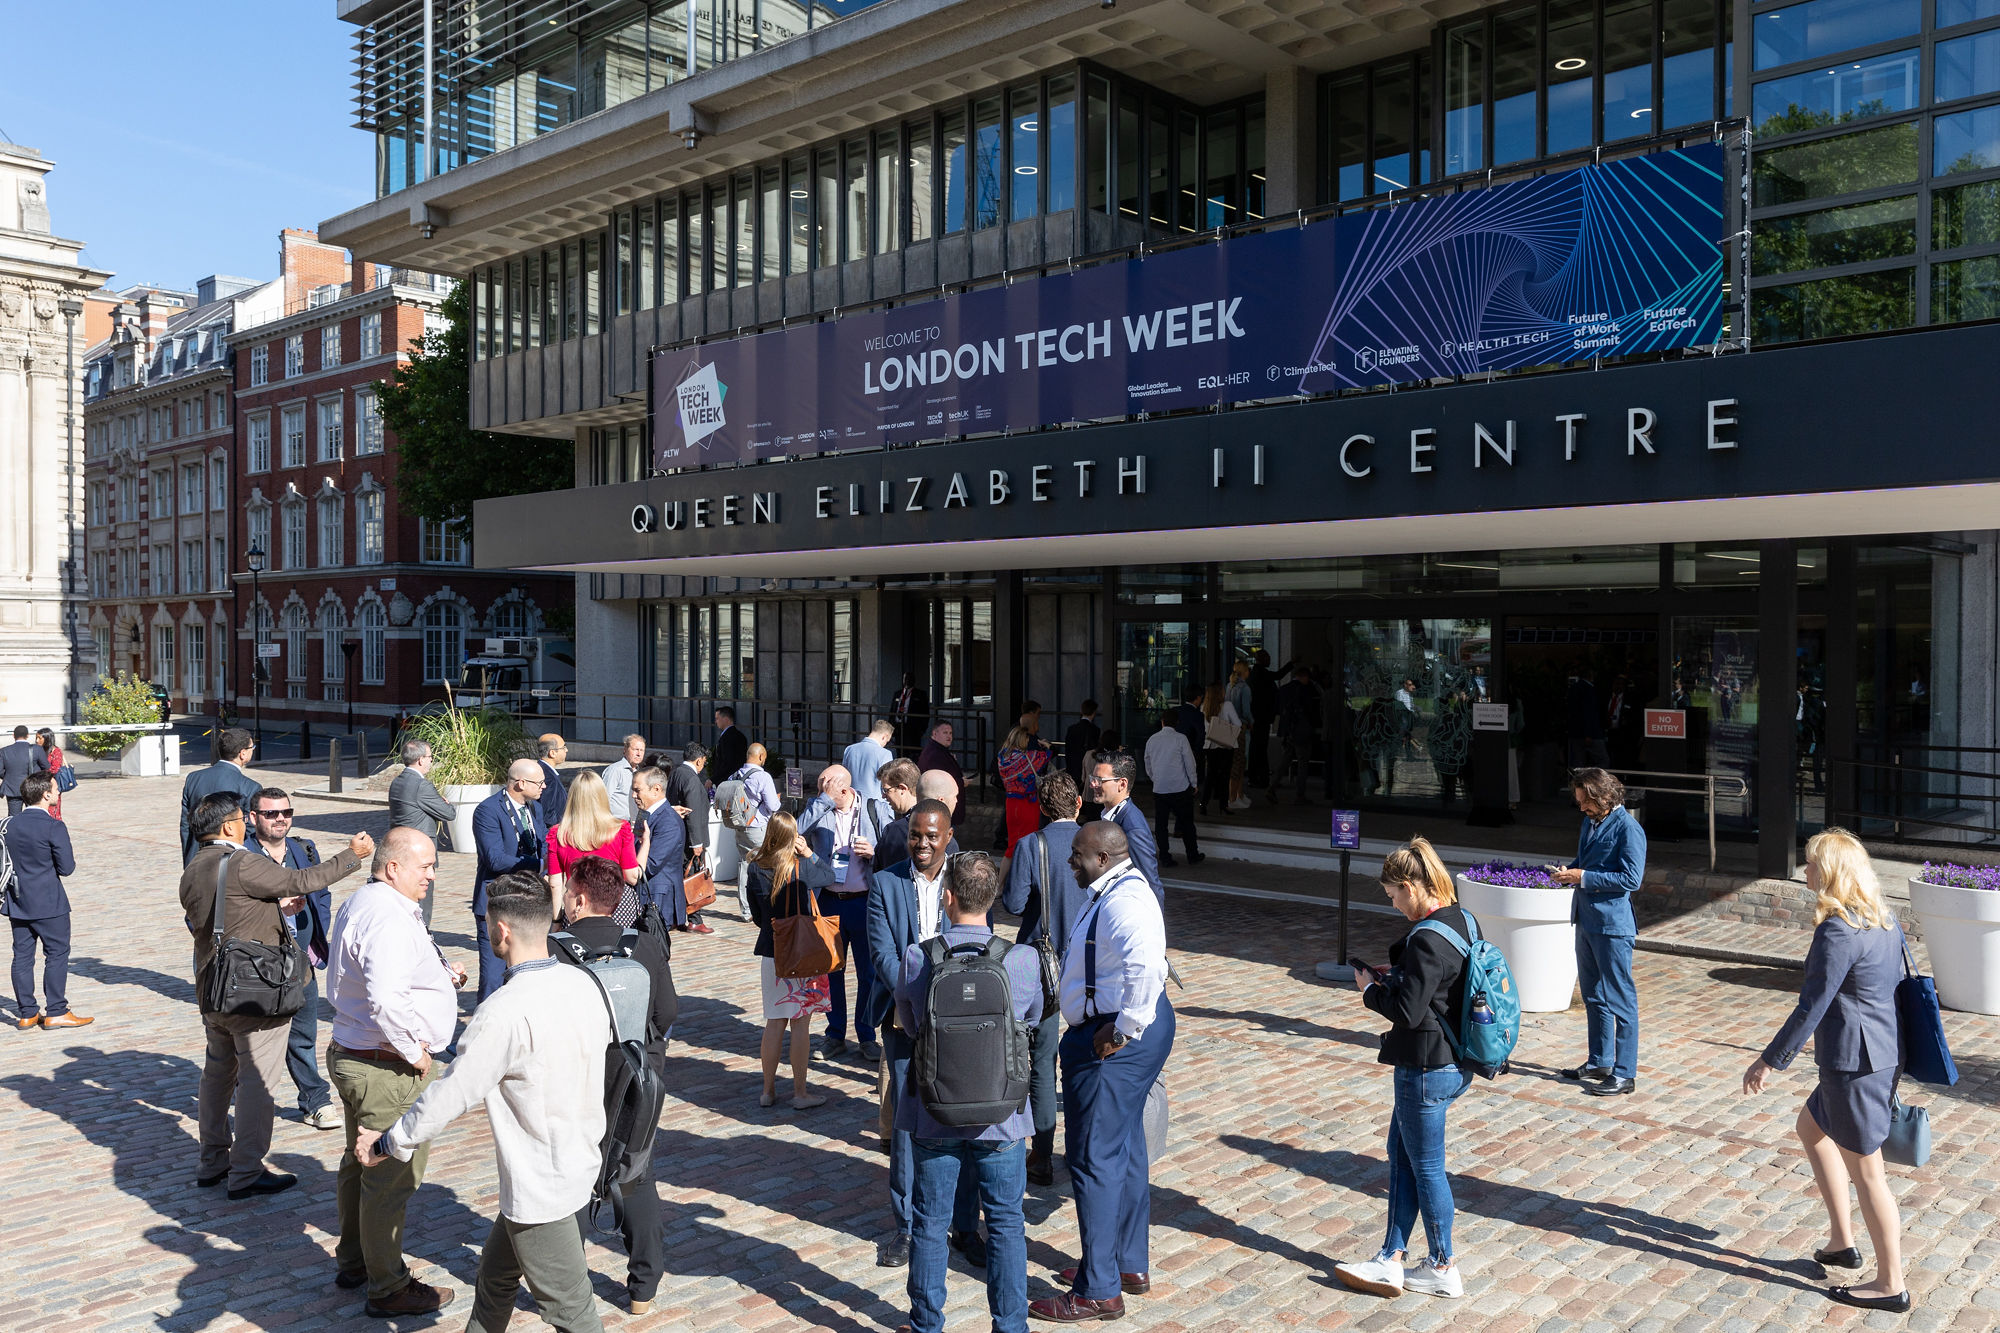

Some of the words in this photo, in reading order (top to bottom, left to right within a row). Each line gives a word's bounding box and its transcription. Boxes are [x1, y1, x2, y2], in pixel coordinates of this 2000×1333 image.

[1568, 312, 1608, 325] Future
[1644, 306, 1686, 320] Future
[1574, 325, 1587, 337] of
[1588, 322, 1620, 335] Work
[1650, 317, 1696, 333] EdTech
[864, 329, 921, 352] WELCOME
[924, 326, 941, 340] TO
[864, 337, 1005, 395] LONDON
[1014, 319, 1112, 370] TECH
[1122, 296, 1246, 353] WEEK
[1459, 337, 1509, 352] HEALTH
[1514, 332, 1549, 345] TECH
[1573, 334, 1620, 350] Summit
[1379, 345, 1420, 358] ELEVATING
[1379, 354, 1420, 366] FOUNDERS
[1128, 383, 1146, 392] Global
[1146, 382, 1168, 390] Leaders
[1198, 372, 1250, 389] EQL:HER
[680, 384, 706, 394] LONDON
[1130, 388, 1160, 398] Innovation
[1160, 386, 1182, 395] Summit
[680, 391, 710, 410] TECH
[688, 406, 721, 426] WEEK
[798, 432, 816, 440] LONDON
[664, 448, 680, 458] #LTW
[631, 492, 776, 534] QUEEN
[815, 455, 1146, 519] ELIZABETH
[1213, 444, 1265, 488] II
[1339, 398, 1739, 479] CENTRE
[1658, 716, 1672, 724] NO
[1652, 724, 1679, 732] ENTRY
